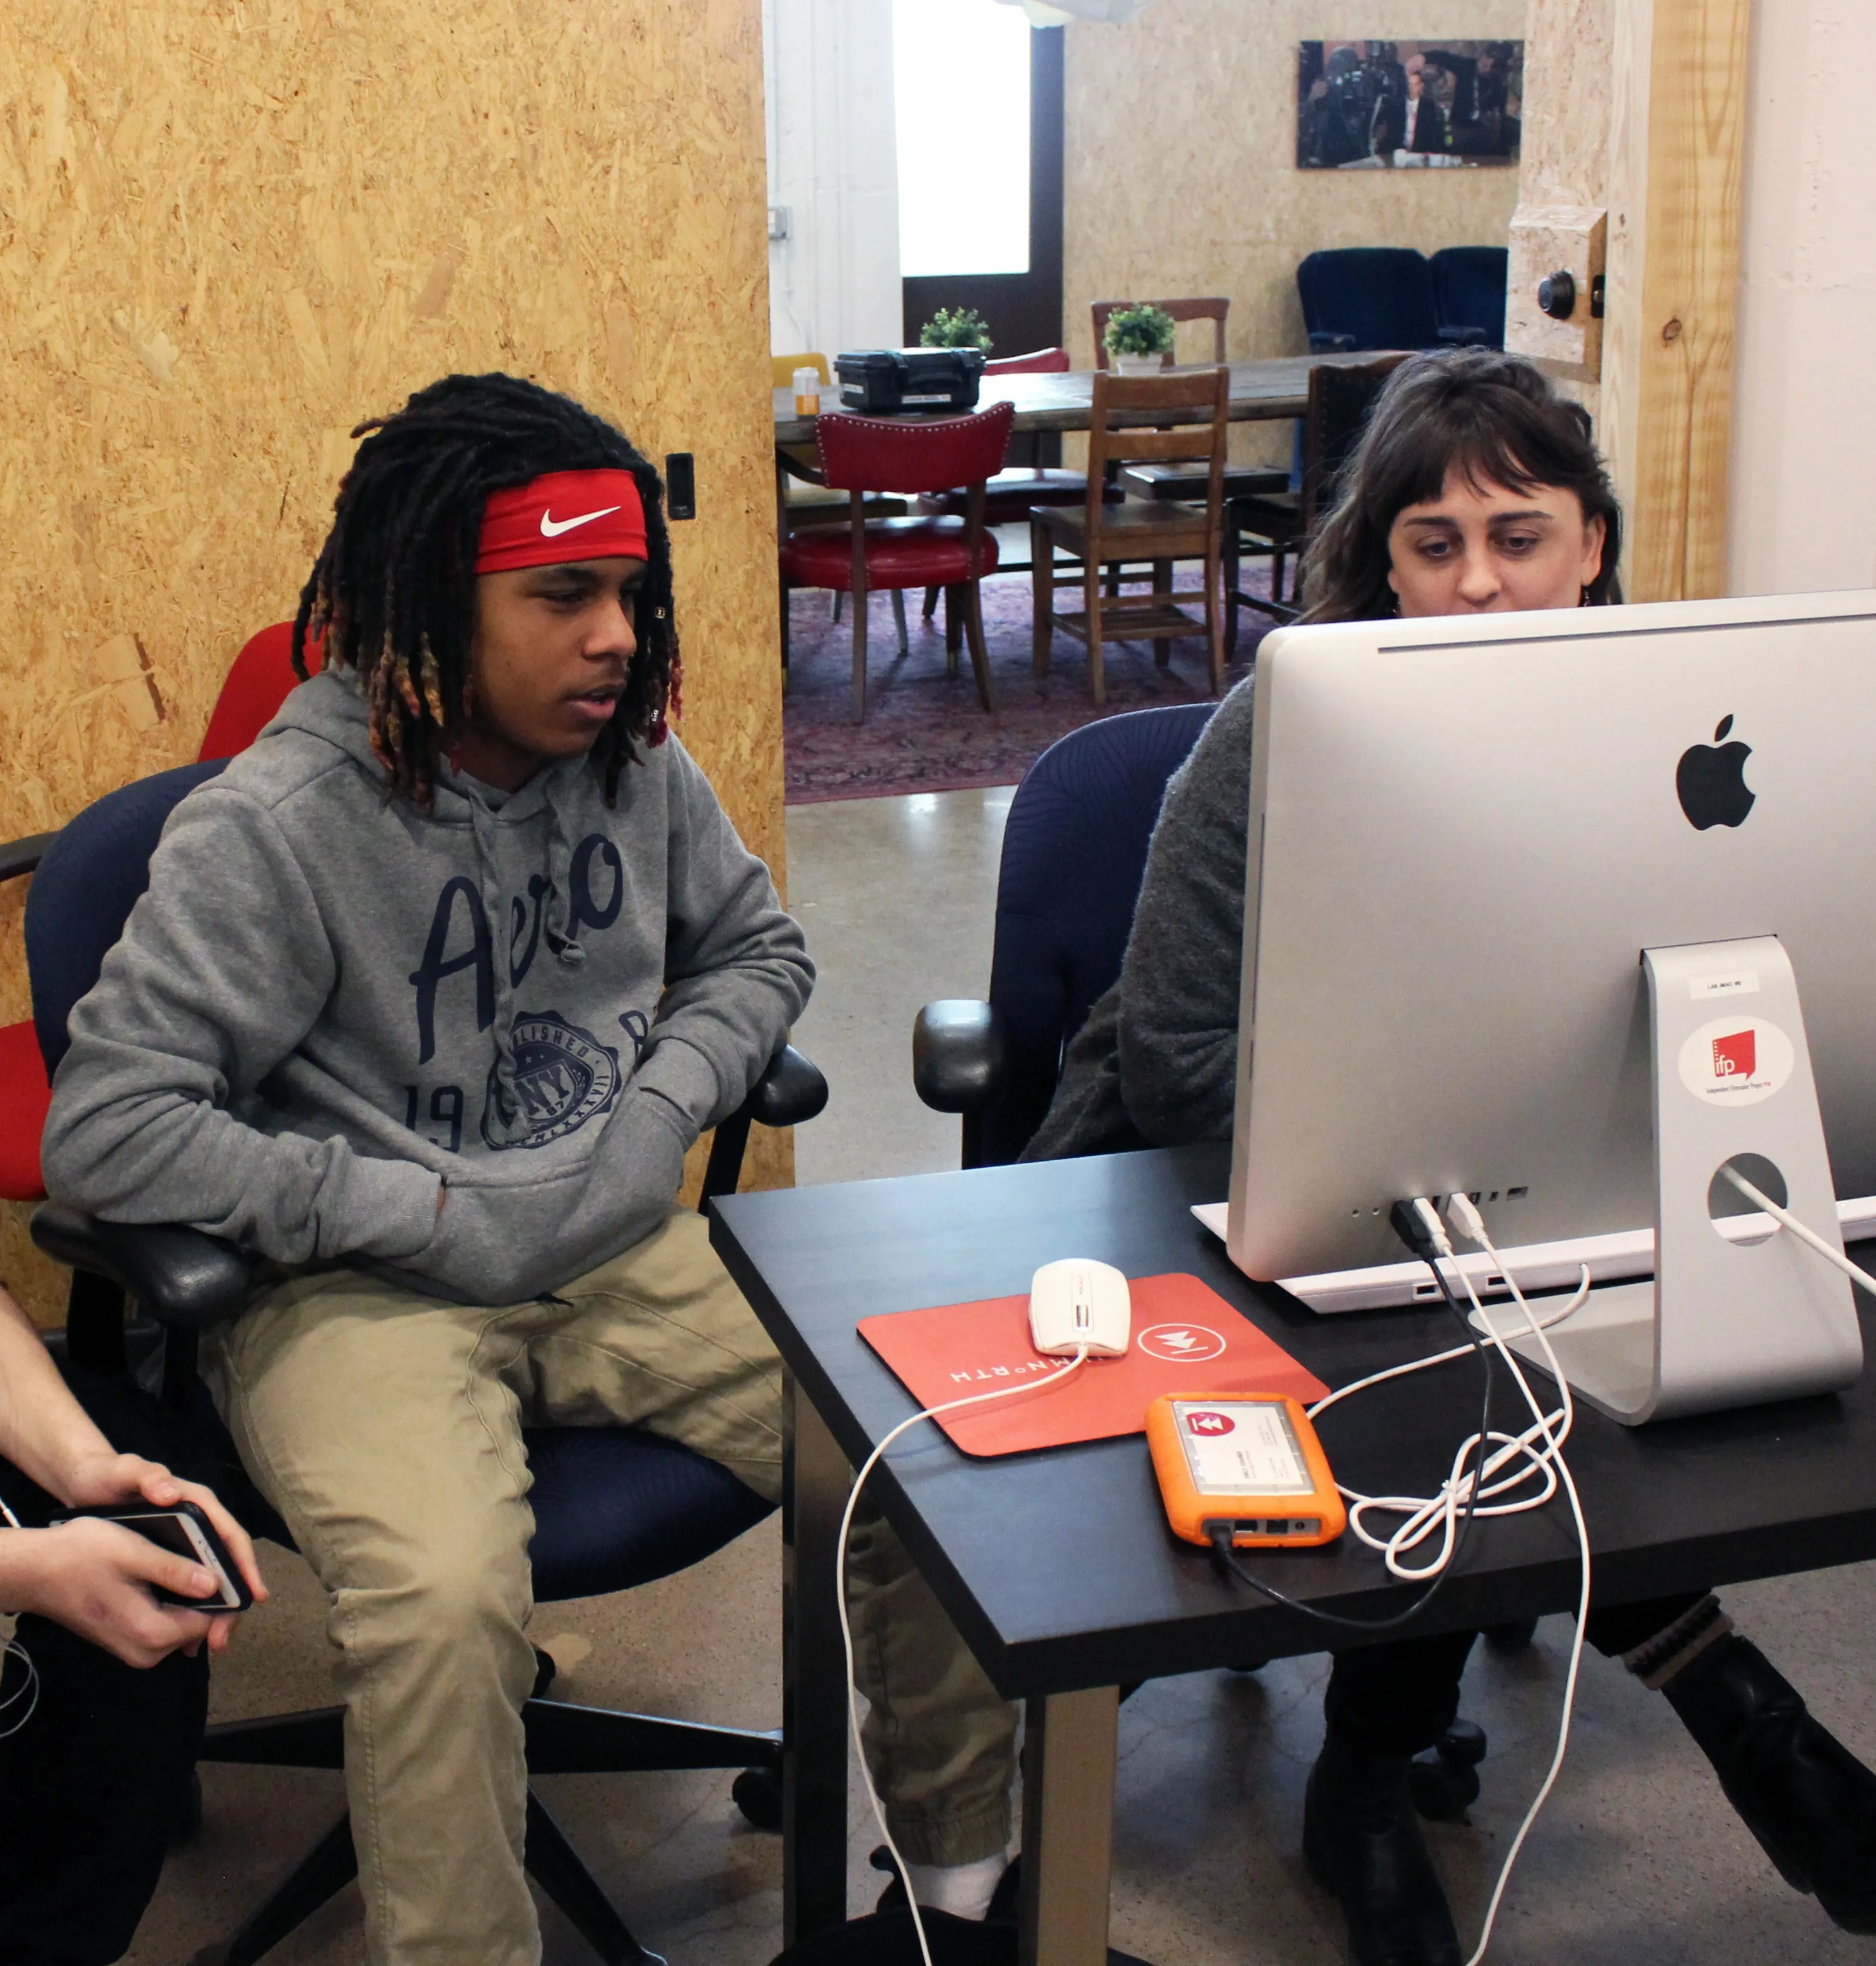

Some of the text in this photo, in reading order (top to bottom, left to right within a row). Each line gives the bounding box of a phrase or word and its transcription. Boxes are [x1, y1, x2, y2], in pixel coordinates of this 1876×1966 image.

[1715, 1054, 1735, 1076] ifp
[514, 1064, 570, 1117] NY
[950, 1356, 1102, 1383] MNORTH
